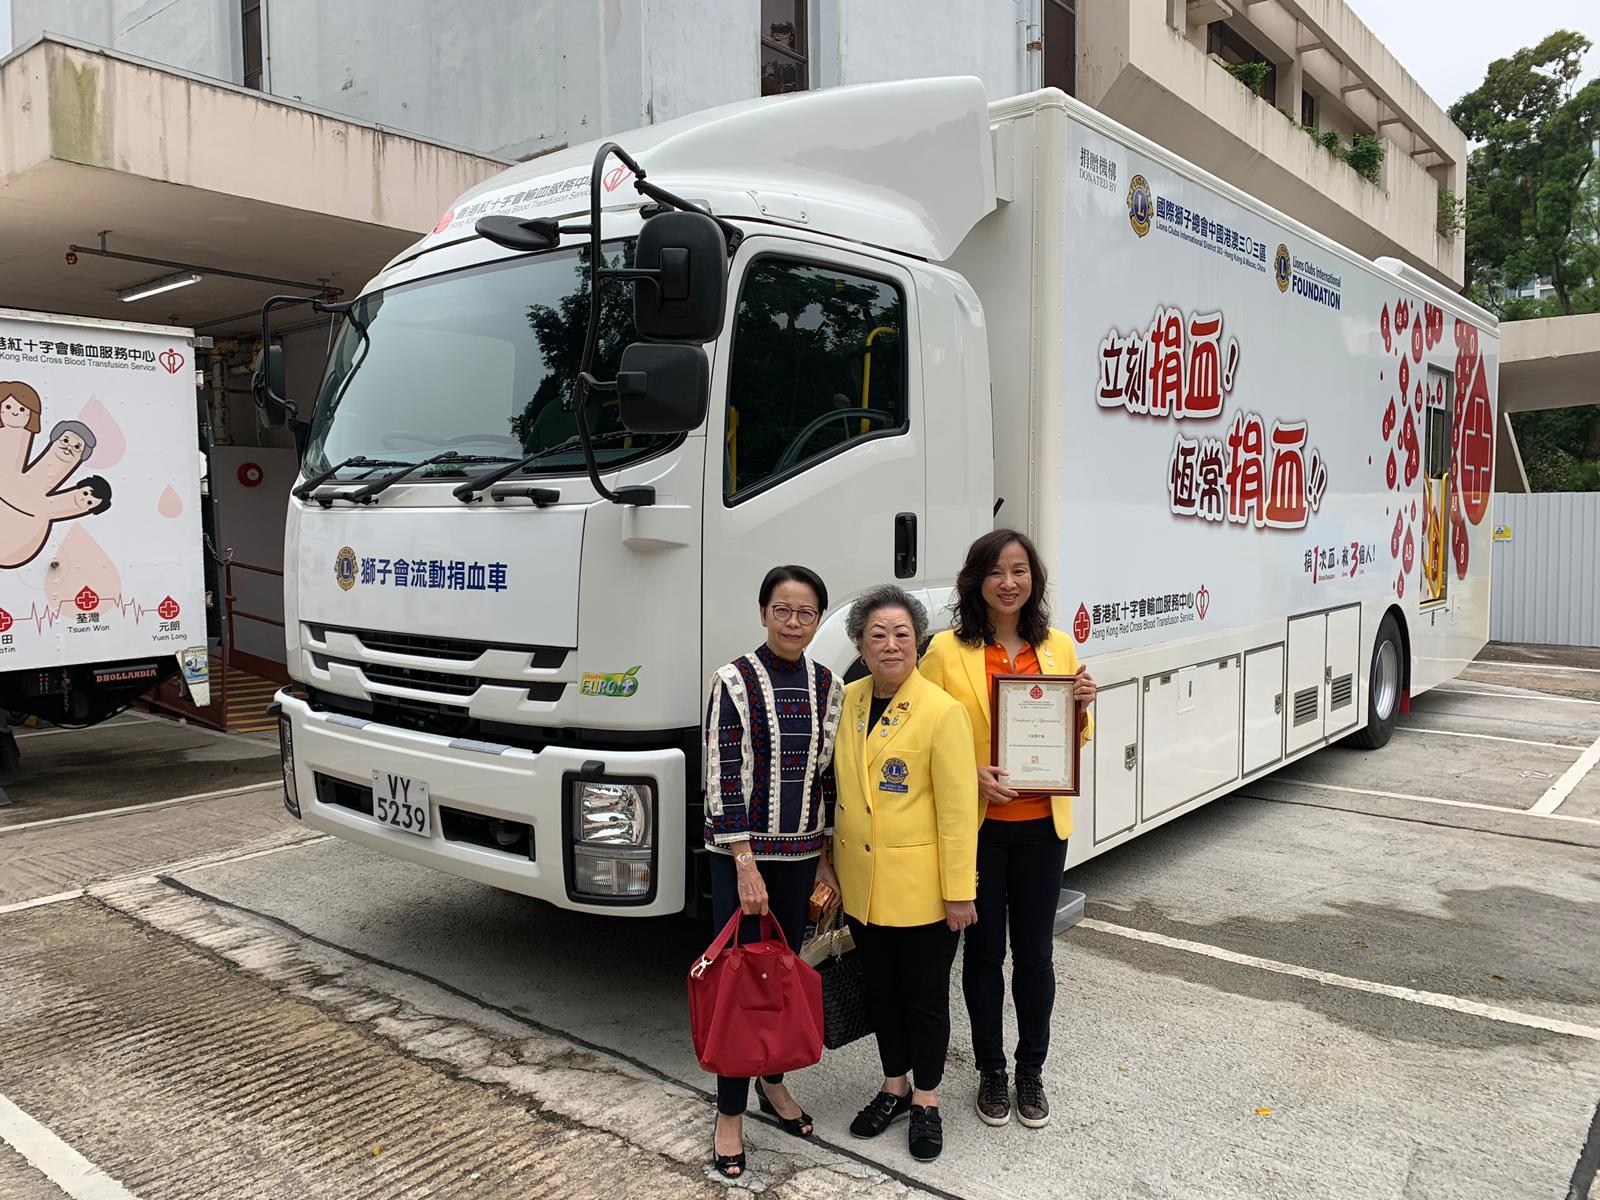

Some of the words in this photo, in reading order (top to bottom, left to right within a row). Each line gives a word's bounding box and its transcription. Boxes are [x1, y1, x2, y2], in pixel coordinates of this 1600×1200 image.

[1079, 168, 1109, 190] DONATED
[1109, 181, 1118, 193] BY
[456, 175, 592, 219] 香港紅十字會輸血服務中
[1137, 194, 1145, 217] L
[1156, 220, 1168, 233] Lions
[1168, 225, 1180, 237] Clubs
[1180, 229, 1204, 247] International
[1224, 248, 1234, 262] Hong
[1292, 255, 1304, 271] Lions
[1304, 261, 1316, 277] Clubs
[1316, 266, 1342, 288] International
[1292, 274, 1341, 311] FOUNDATION
[1415, 332, 1420, 350] O
[1470, 333, 1475, 354] O
[22, 353, 38, 362] Red
[40, 355, 63, 364] Cross
[64, 357, 86, 366] Blood
[87, 359, 129, 370] Transfusion
[130, 362, 156, 372] Service
[1465, 358, 1470, 375] A
[1411, 448, 1417, 466] A
[1389, 464, 1394, 479] O
[1405, 543, 1413, 562] AB
[1460, 543, 1465, 564] B
[343, 560, 350, 576] L
[361, 557, 508, 593] 獅子會流動捐血車
[76, 612, 100, 624] 荃灣
[1092, 592, 1195, 625] 香港紅十字會輸血服務中心
[67, 626, 91, 634] Tsuen
[159, 621, 181, 632] 元朗
[1092, 628, 1105, 640] Hong
[1106, 626, 1119, 638] Kong
[1119, 623, 1129, 634] Red
[1129, 621, 1143, 633] Cross
[1143, 619, 1156, 630] Blood
[1156, 615, 1179, 628] Transfusion
[1180, 612, 1195, 623] Service
[1, 634, 13, 645] 田
[152, 634, 170, 642] Yuen
[171, 633, 188, 641] Long
[96, 669, 157, 683] DHOLLANDIA
[582, 680, 618, 695] EURO
[892, 765, 899, 776] L
[387, 773, 411, 803] VY
[377, 796, 426, 832] 5239
